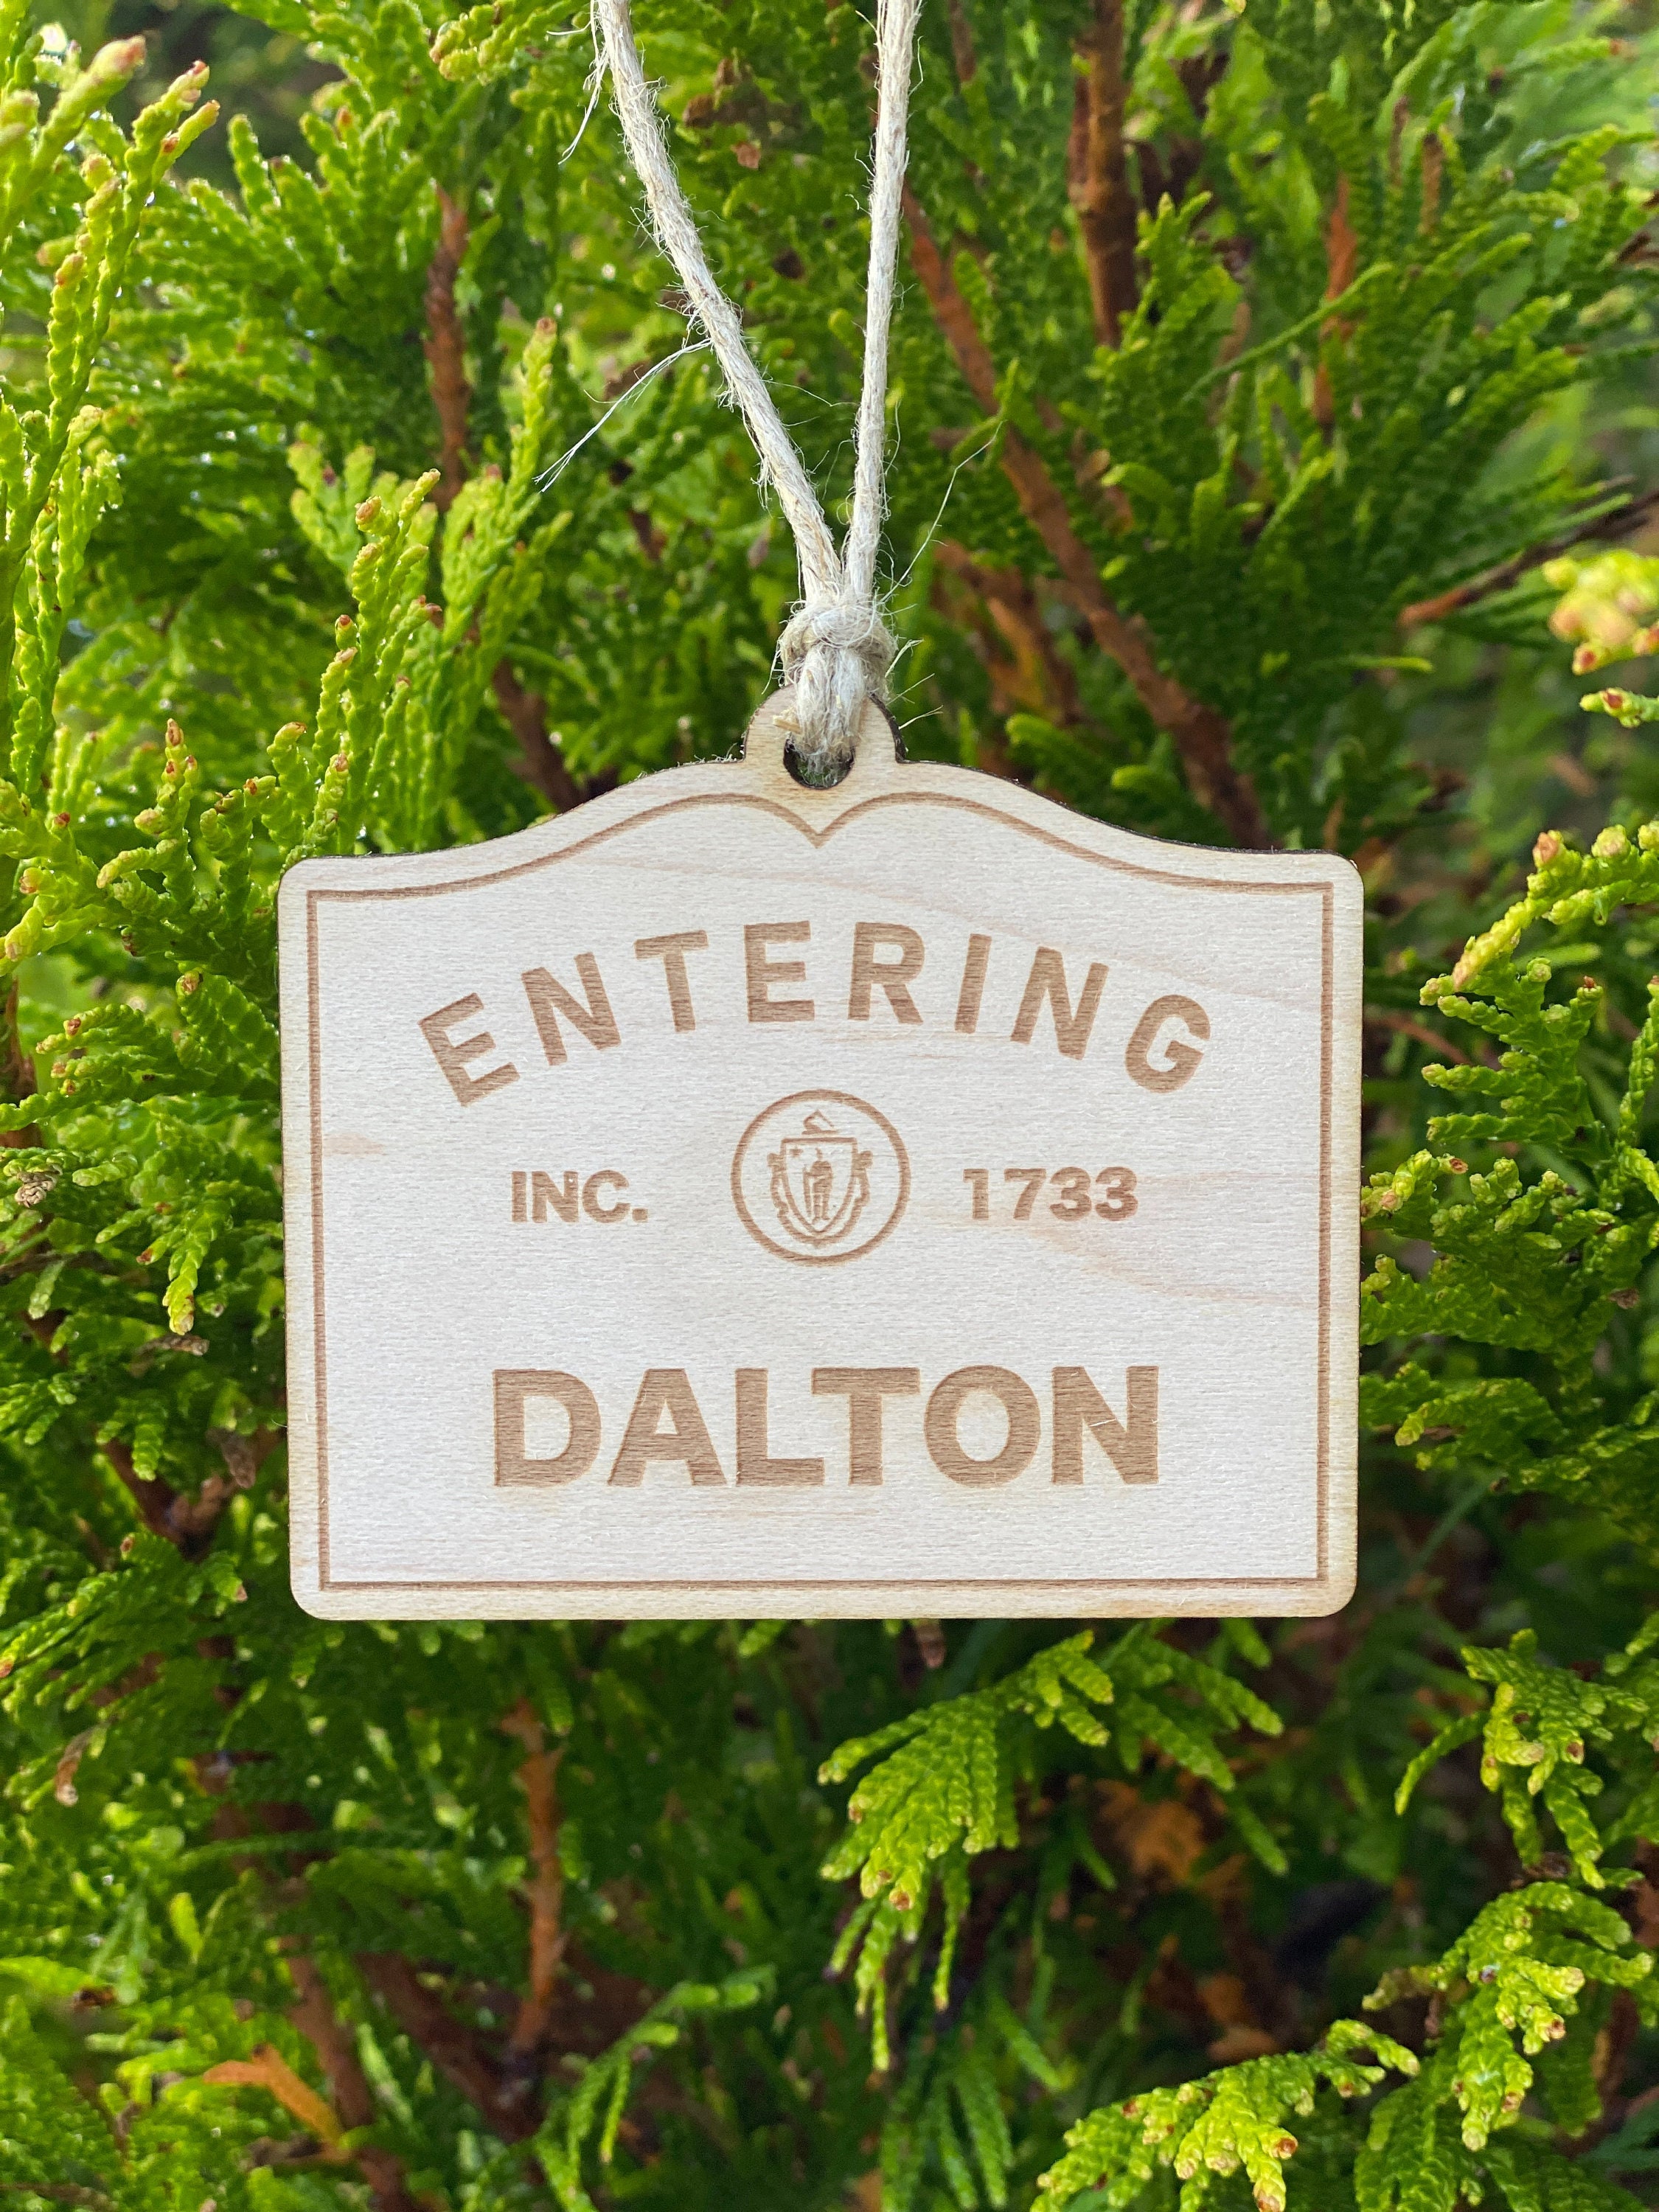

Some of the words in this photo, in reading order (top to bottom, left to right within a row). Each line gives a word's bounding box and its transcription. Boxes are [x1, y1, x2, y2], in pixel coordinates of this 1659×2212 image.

[419, 921, 1210, 1107] ENTERING
[512, 1169, 647, 1224] INC.
[963, 1166, 1138, 1222] 1733
[493, 1365, 1158, 1487] DALTON
